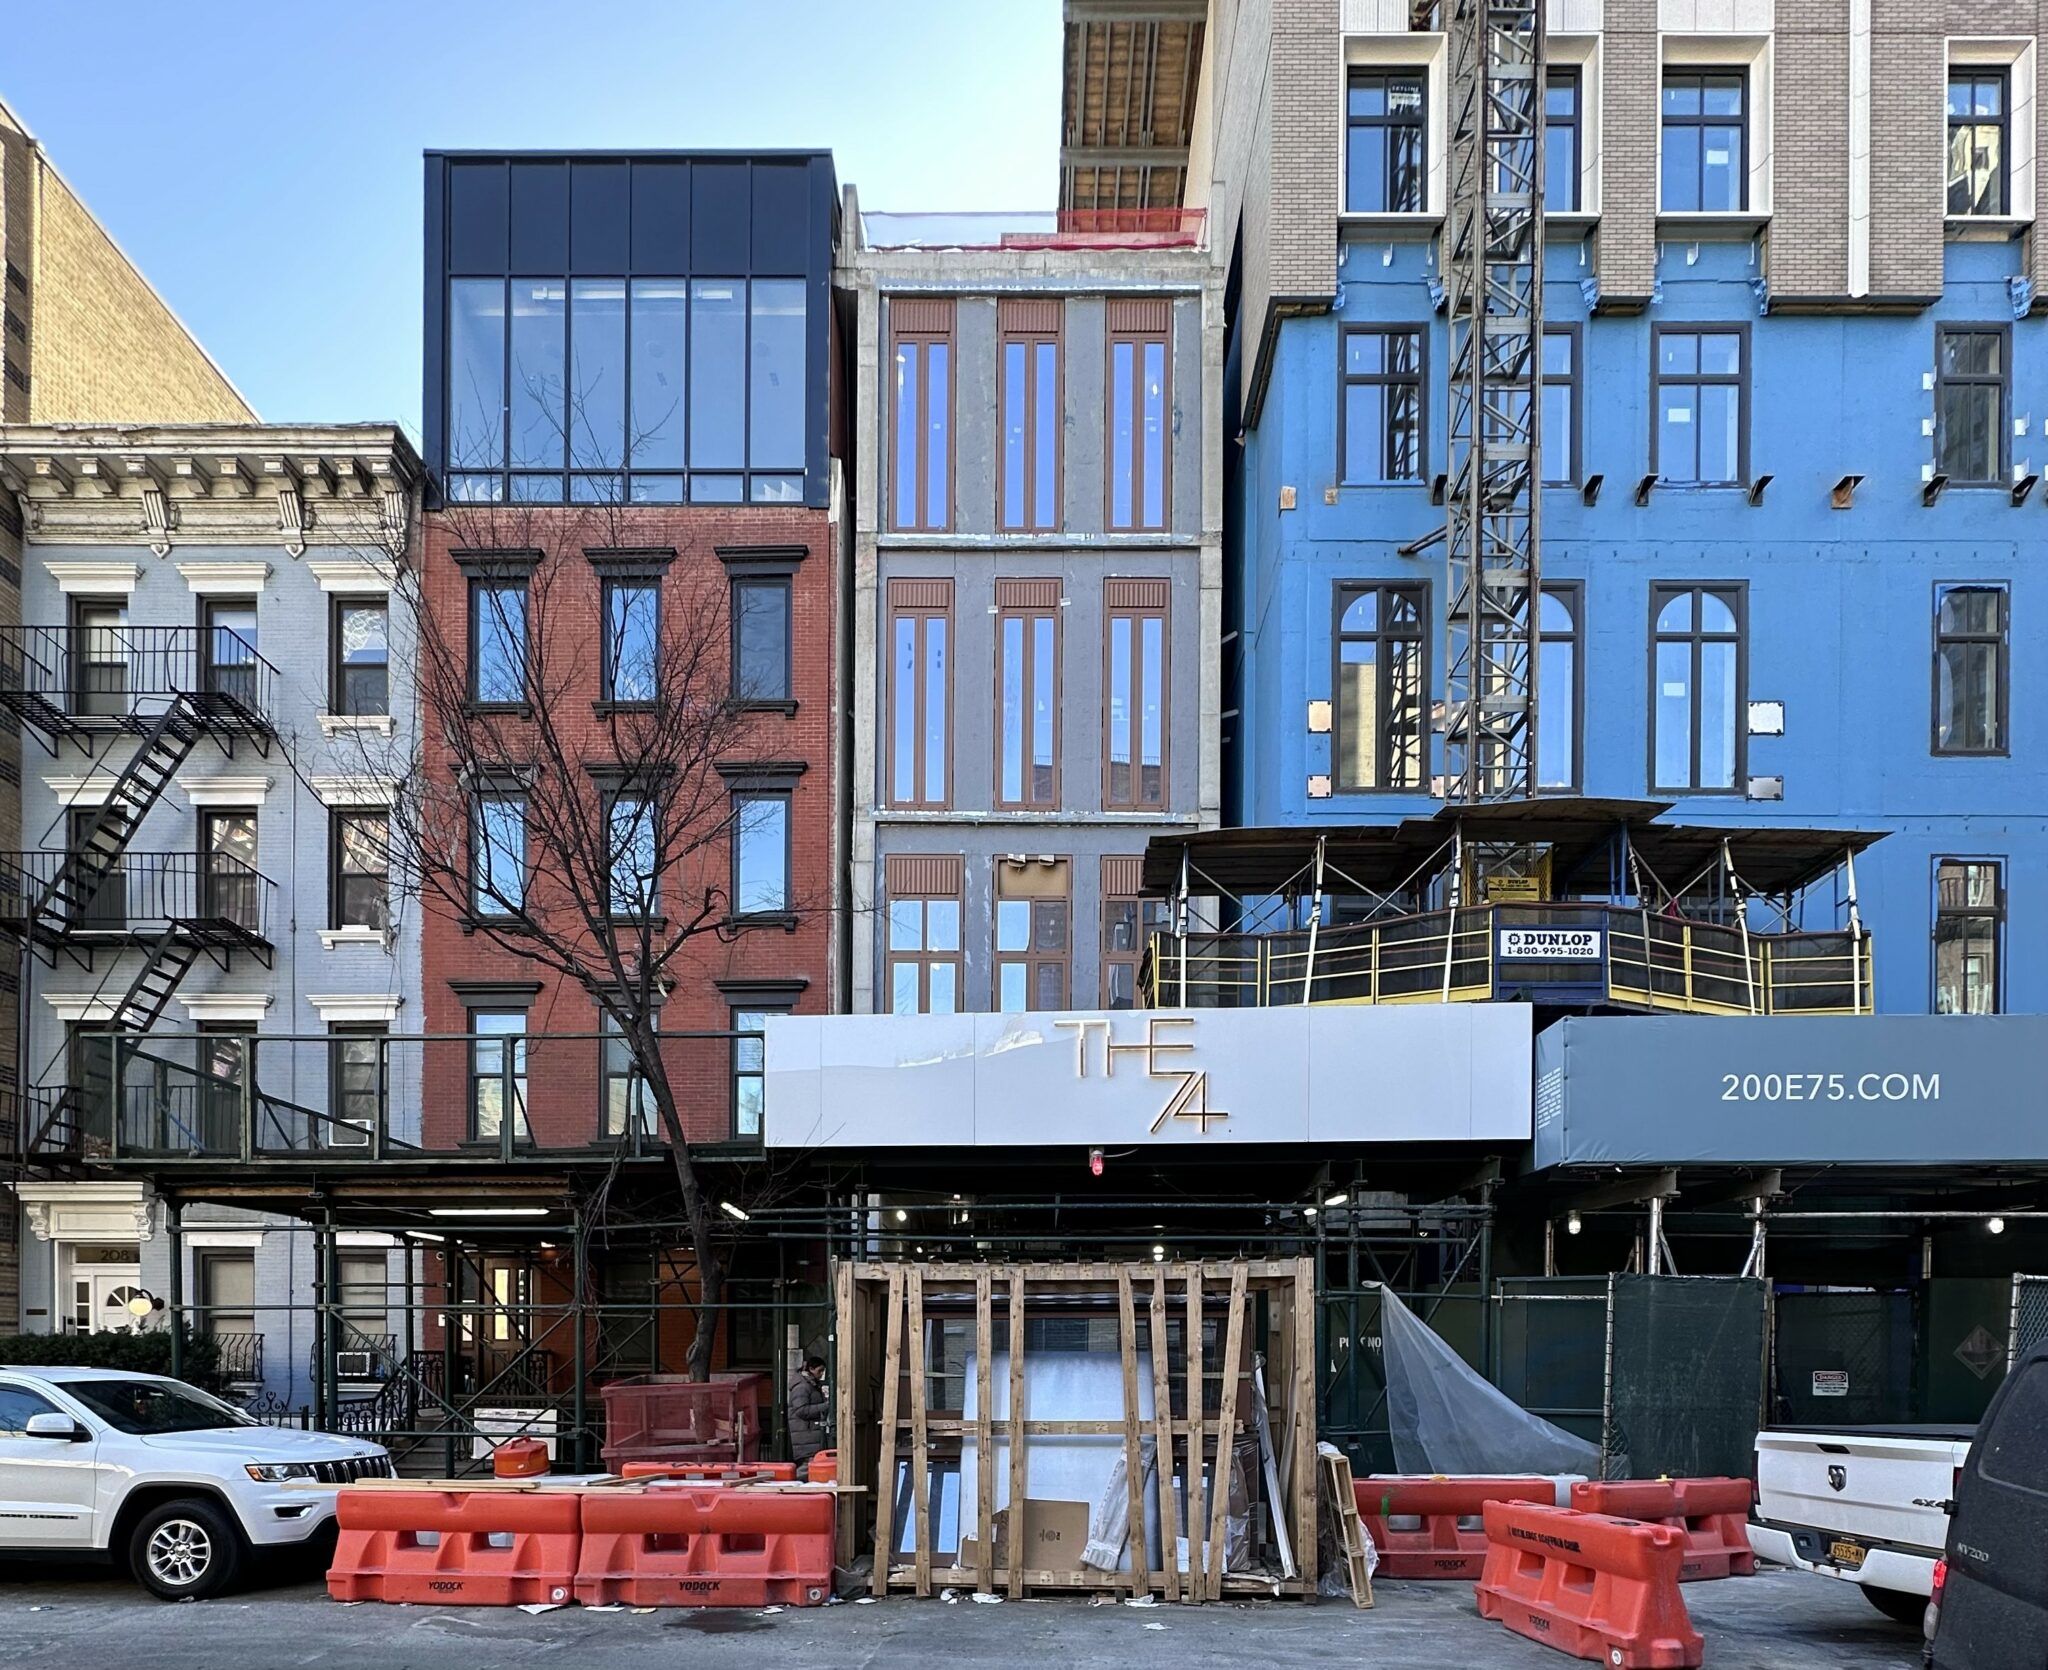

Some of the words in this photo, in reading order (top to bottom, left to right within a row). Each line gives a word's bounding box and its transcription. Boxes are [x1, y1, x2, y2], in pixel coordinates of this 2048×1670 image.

[1523, 933, 1593, 946] DUNLOP
[1507, 946, 1594, 956] 1-800-995-1020
[1053, 1018, 1195, 1077] THE
[1721, 1073, 1941, 1101] 200E75.COM
[1150, 1070, 1229, 1133] 74
[101, 1249, 130, 1261] 208
[1367, 1336, 1382, 1348] NO
[429, 1581, 464, 1590] YODOCK
[679, 1581, 721, 1591] YODOCK
